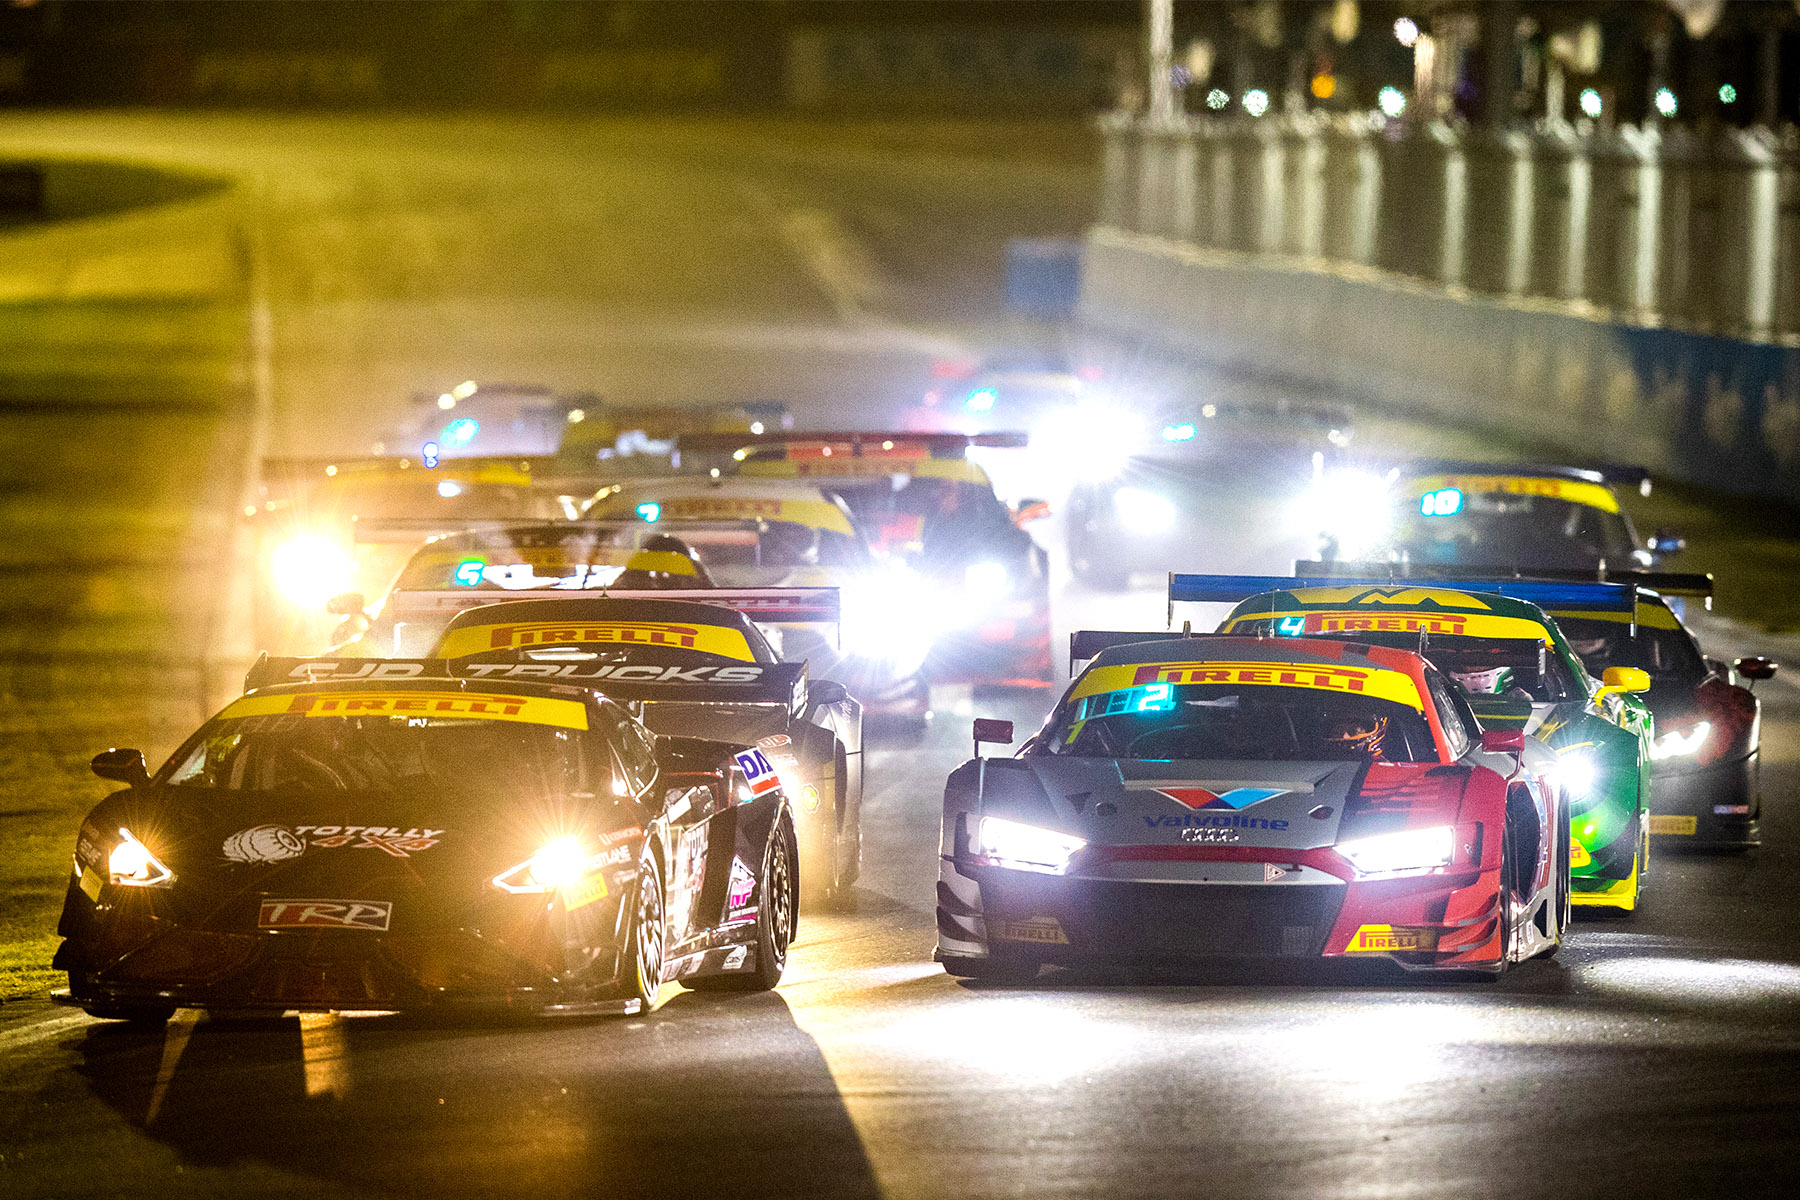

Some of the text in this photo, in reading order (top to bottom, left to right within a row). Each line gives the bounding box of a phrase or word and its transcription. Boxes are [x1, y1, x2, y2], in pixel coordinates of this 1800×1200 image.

[1280, 616, 1305, 636] 4
[1304, 611, 1467, 635] PIRELLI
[490, 621, 699, 648] PIRELLI
[288, 662, 764, 682] CJD TRUCKS
[1132, 663, 1368, 691] PIRELLI
[287, 692, 528, 716] PIRELLI
[1137, 684, 1172, 712] 2
[295, 825, 446, 839] TOTALLY
[1144, 814, 1290, 832] Valvoline
[1004, 922, 1060, 939] PIRELLI
[1359, 931, 1421, 948] PIRELLI
